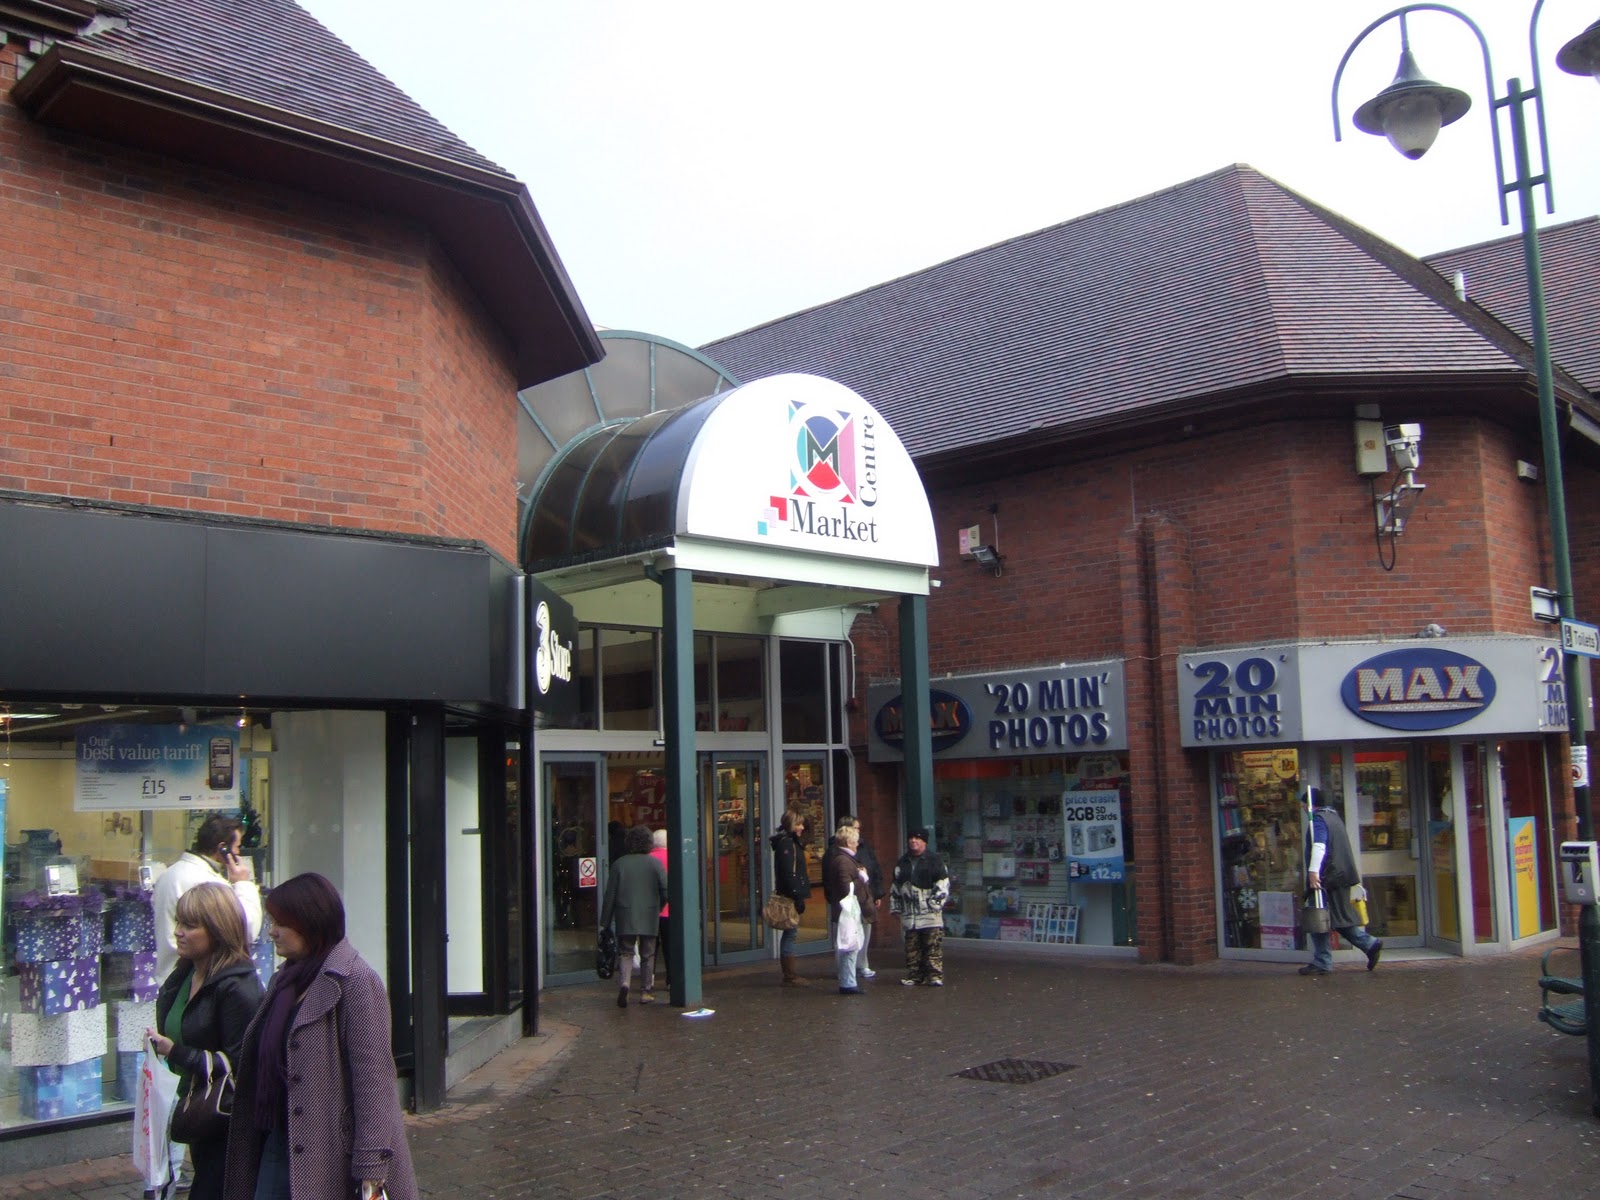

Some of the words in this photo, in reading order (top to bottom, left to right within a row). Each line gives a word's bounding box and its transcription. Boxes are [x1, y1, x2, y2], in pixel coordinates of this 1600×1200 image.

[859, 415, 878, 507] Centre
[789, 498, 878, 543] Market
[1573, 630, 1595, 648] Toilets
[550, 629, 571, 682] Store
[1356, 665, 1484, 702] MAX
[1194, 693, 1280, 717] MIN
[882, 700, 961, 733] MX
[1194, 714, 1281, 740] PHOTOS
[88, 735, 110, 747] Our
[989, 712, 1109, 749] PHOTOS
[82, 743, 115, 760] best
[119, 745, 160, 760] value
[142, 779, 166, 795] £15
[1065, 795, 1087, 805] price
[1066, 806, 1094, 821] 2GB
[1096, 812, 1118, 821] cards
[1091, 868, 1122, 880] £12.99
